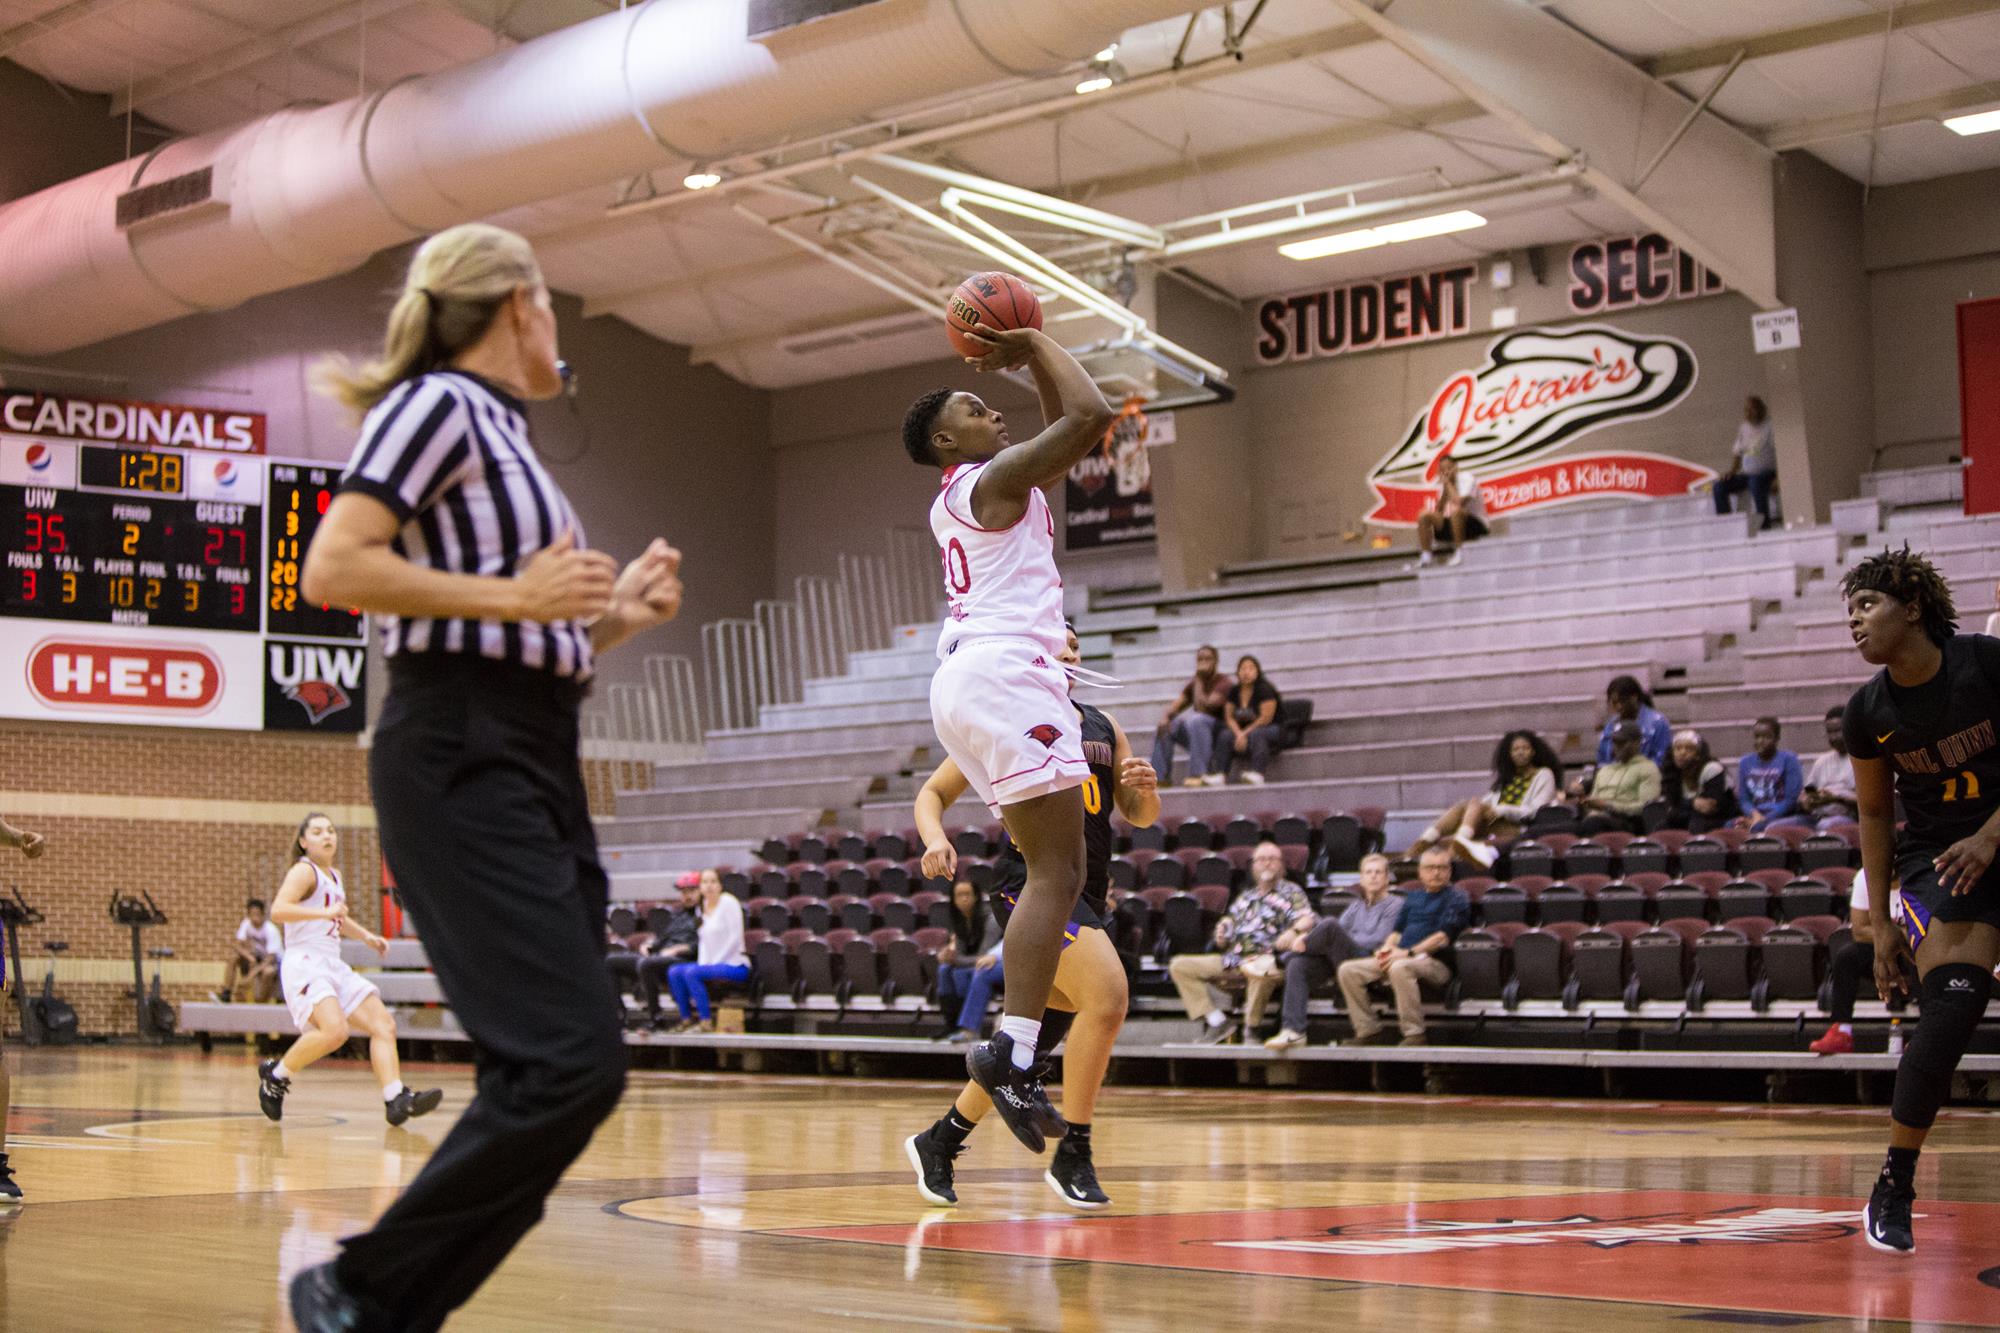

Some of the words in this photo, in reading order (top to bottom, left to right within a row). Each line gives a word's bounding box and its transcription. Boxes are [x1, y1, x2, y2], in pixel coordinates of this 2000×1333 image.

[1258, 265, 1476, 363] STUDENT
[4, 396, 253, 452] CARDINALS
[1426, 346, 1637, 482] Julian's
[120, 453, 182, 494] 1:28
[1482, 474, 1552, 510] Pizzeria
[1556, 472, 1572, 495] &
[1575, 461, 1648, 492] Kitchen
[24, 487, 58, 510] UIW
[195, 501, 247, 525] GUEST
[24, 512, 66, 553] 35
[123, 522, 141, 556] 2
[204, 527, 247, 567] 27
[8, 551, 43, 569] FOULS
[93, 557, 135, 576] PLAYER
[215, 566, 251, 585] FOULS
[271, 560, 298, 586] 20
[941, 537, 971, 595] 0
[22, 569, 37, 601] 3
[62, 572, 77, 604] 3
[109, 576, 135, 608] 10
[144, 578, 161, 610] 2
[183, 581, 200, 613] 3
[230, 584, 246, 616] 3
[271, 586, 298, 612] 22
[268, 643, 365, 690] UIW
[1937, 719, 1996, 768] QUINN
[1941, 770, 1981, 802] 11
